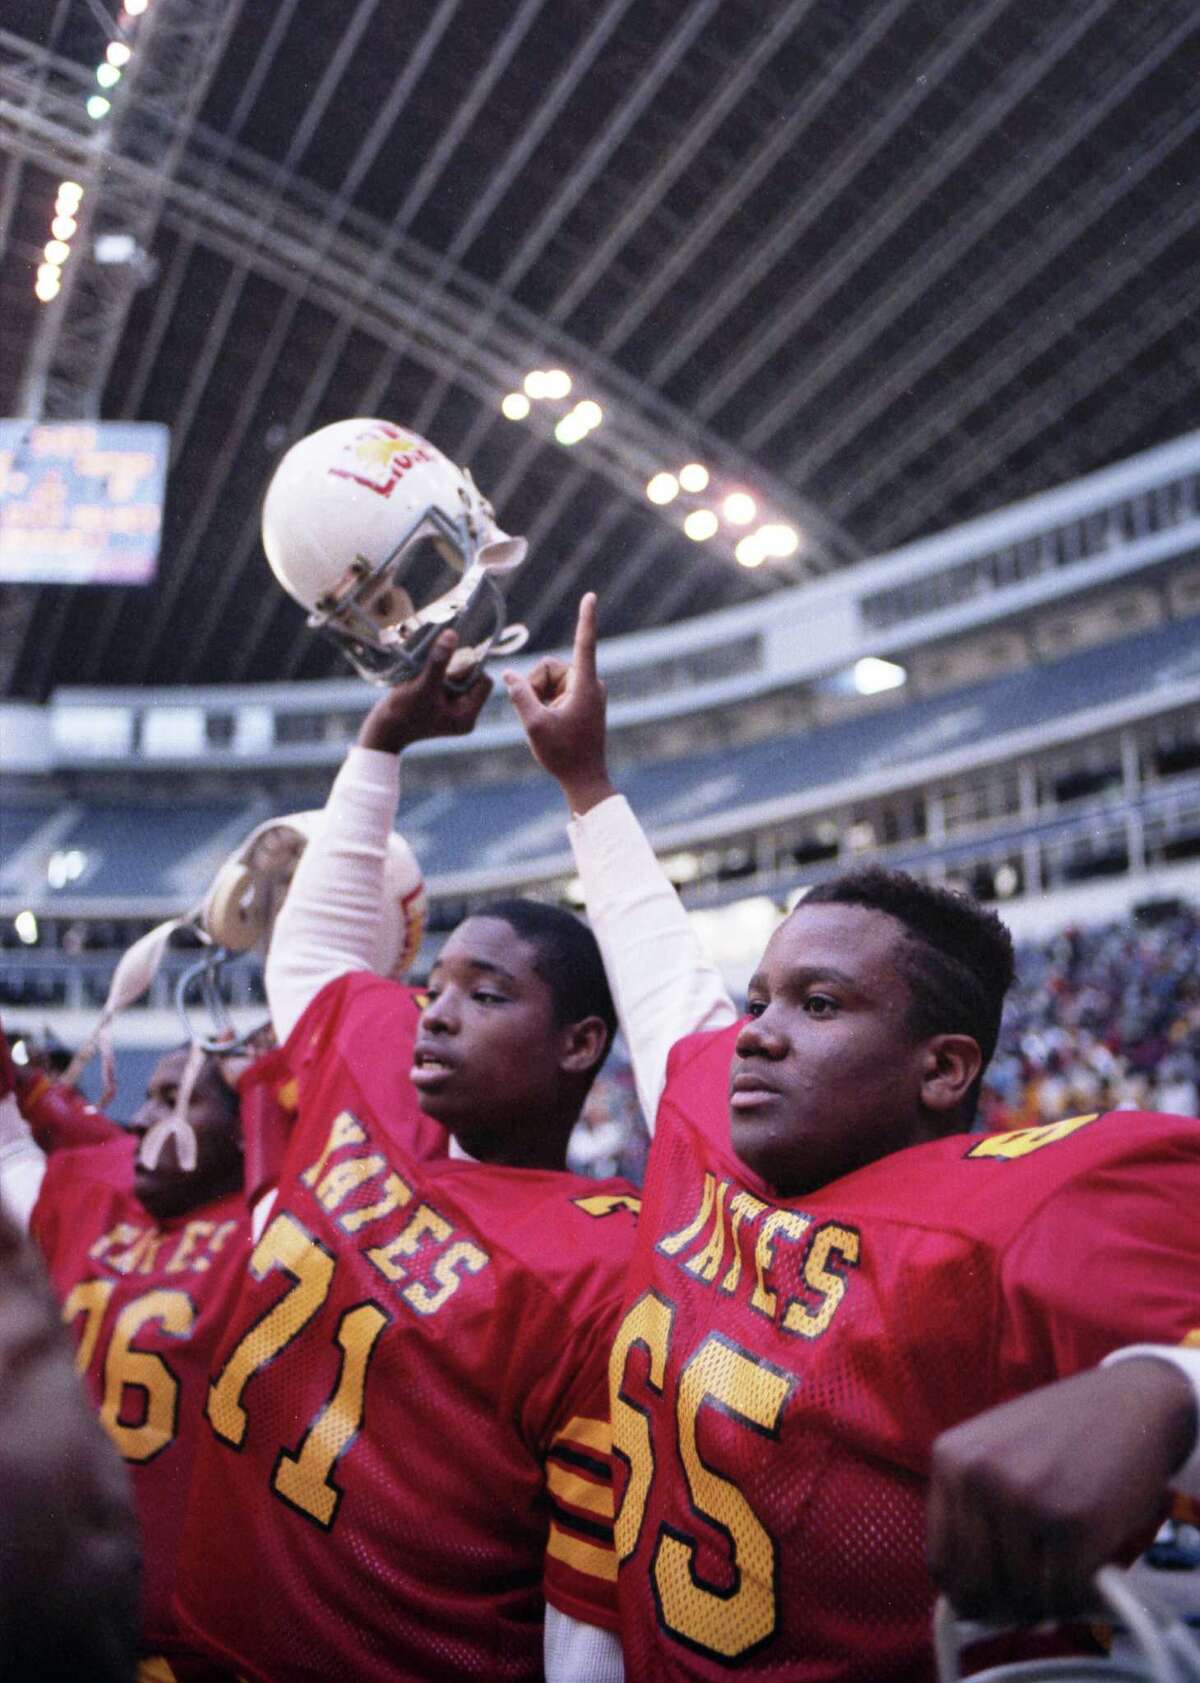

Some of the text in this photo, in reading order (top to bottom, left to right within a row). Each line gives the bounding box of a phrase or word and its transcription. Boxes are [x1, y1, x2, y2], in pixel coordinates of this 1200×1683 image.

[299, 1109, 490, 1316] YATES
[655, 1169, 861, 1341] YATES
[62, 1278, 196, 1467] 76
[206, 1211, 395, 1534] 71
[608, 1286, 801, 1668] 65
